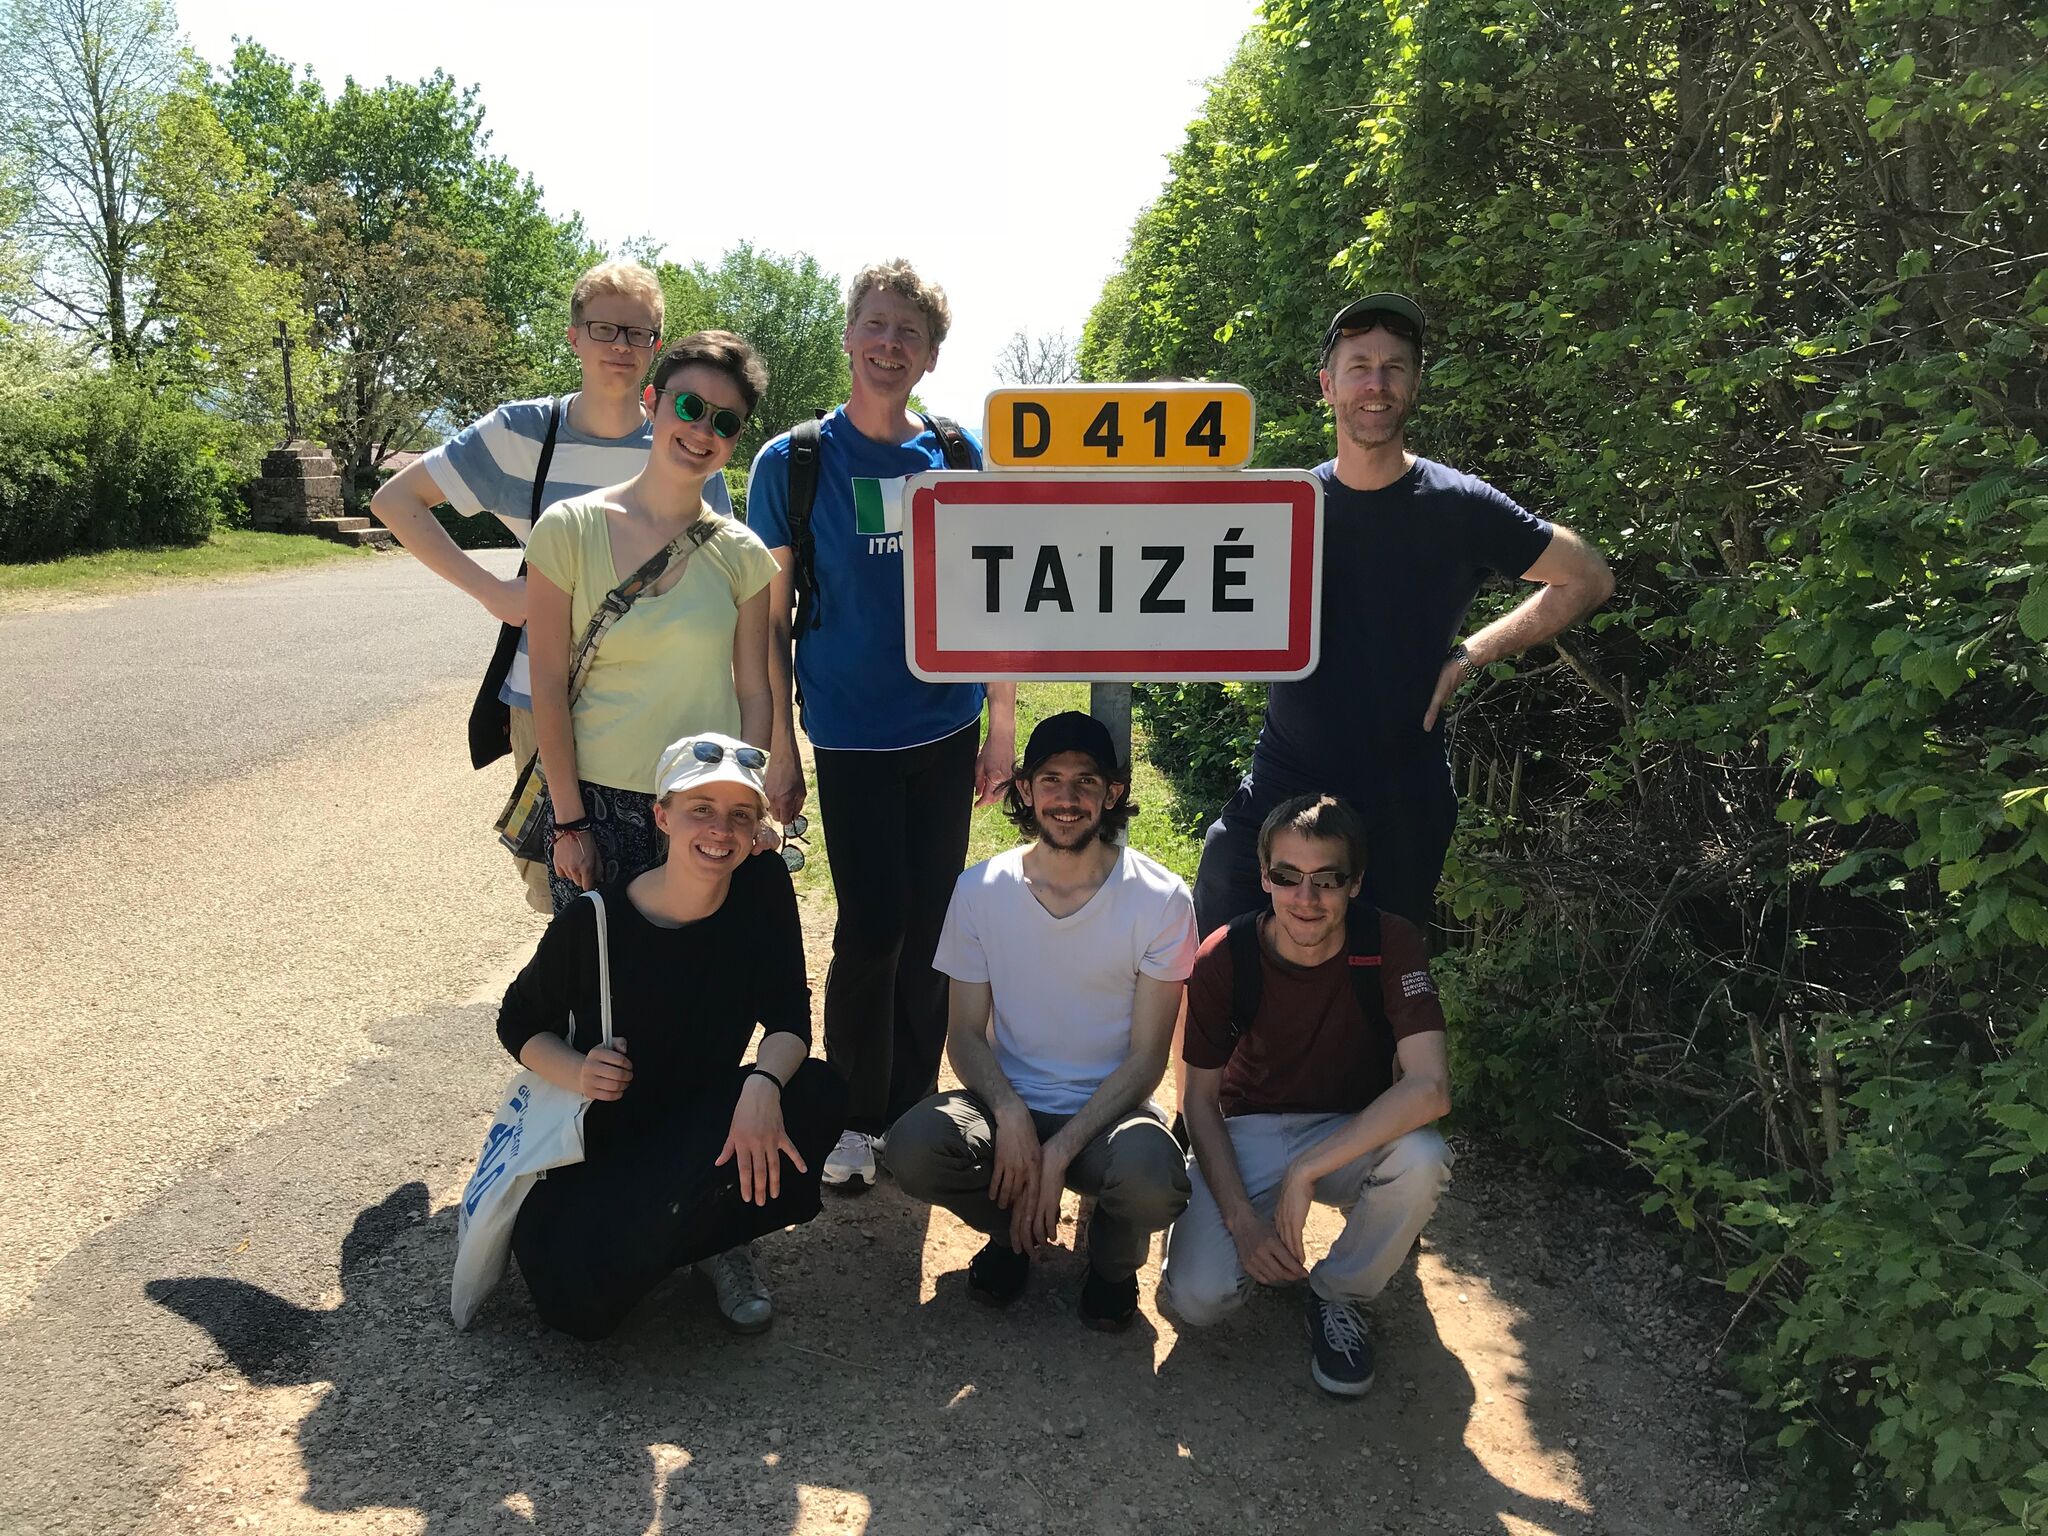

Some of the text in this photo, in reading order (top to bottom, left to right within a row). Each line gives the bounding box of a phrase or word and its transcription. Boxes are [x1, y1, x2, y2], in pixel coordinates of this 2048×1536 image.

[1012, 401, 1227, 458] D 414
[971, 527, 1255, 613] TAIZÉ
